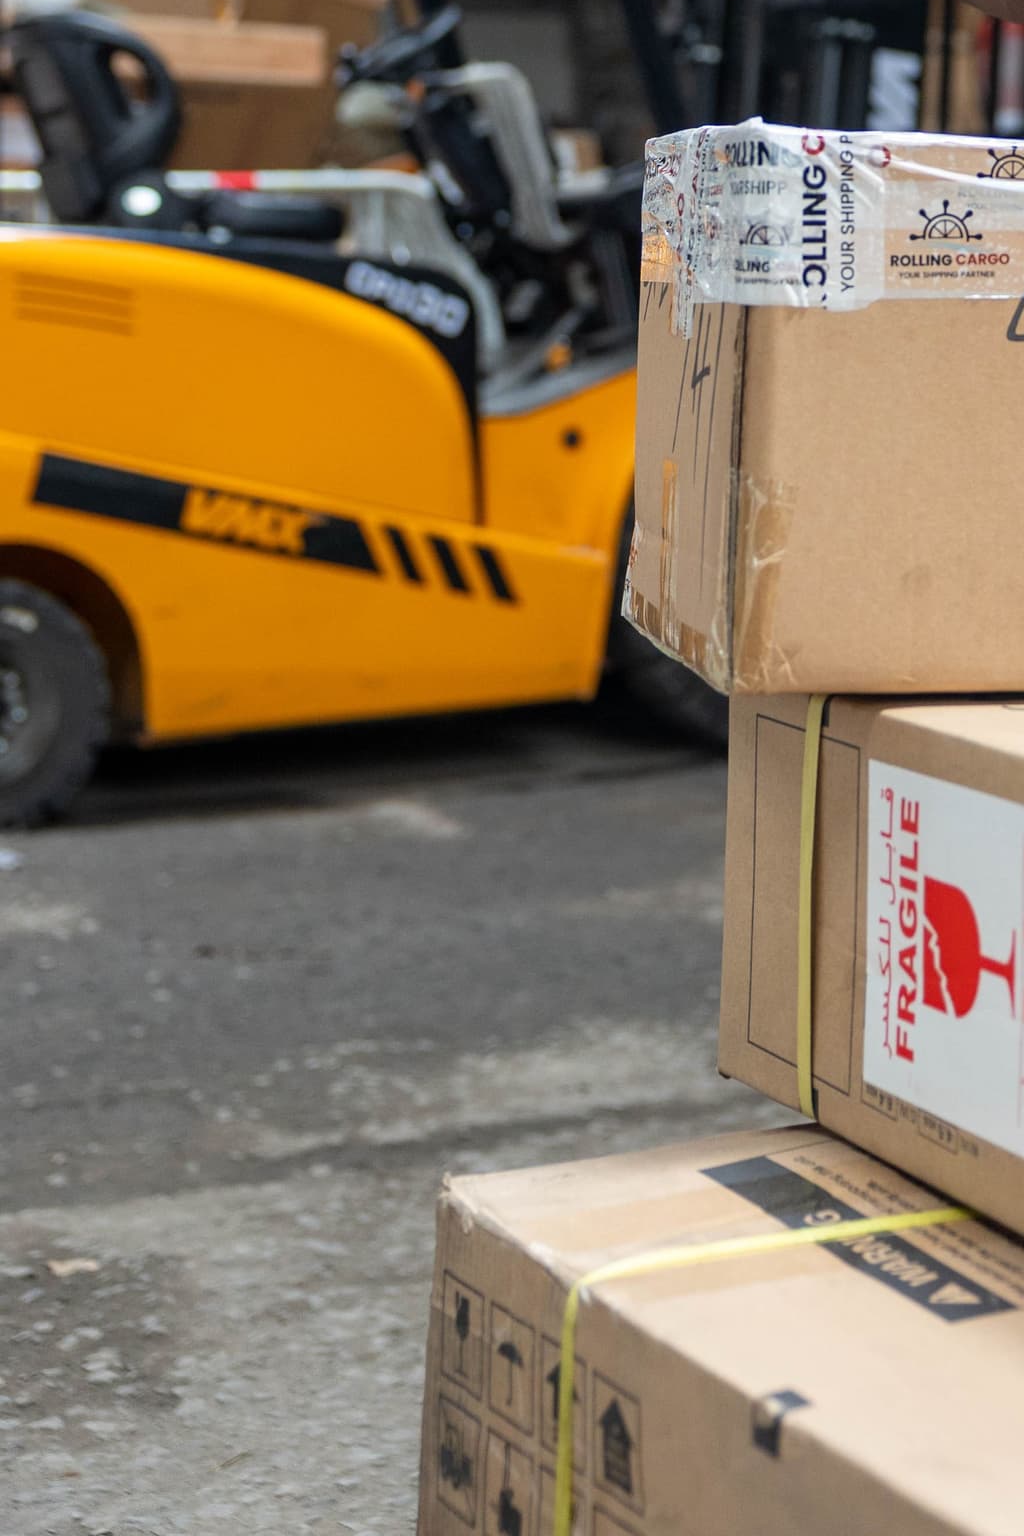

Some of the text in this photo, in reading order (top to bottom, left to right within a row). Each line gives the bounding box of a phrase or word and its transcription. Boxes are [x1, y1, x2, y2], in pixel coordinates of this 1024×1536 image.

[840, 154, 855, 235] SHIPPING
[803, 164, 828, 307] OLLING
[840, 242, 855, 292] YOUR
[890, 253, 1010, 267] ROLLING CARGO
[960, 269, 995, 279] PARTNER
[895, 797, 921, 1064] FRAGILE
[802, 1209, 939, 1288] WARNG
